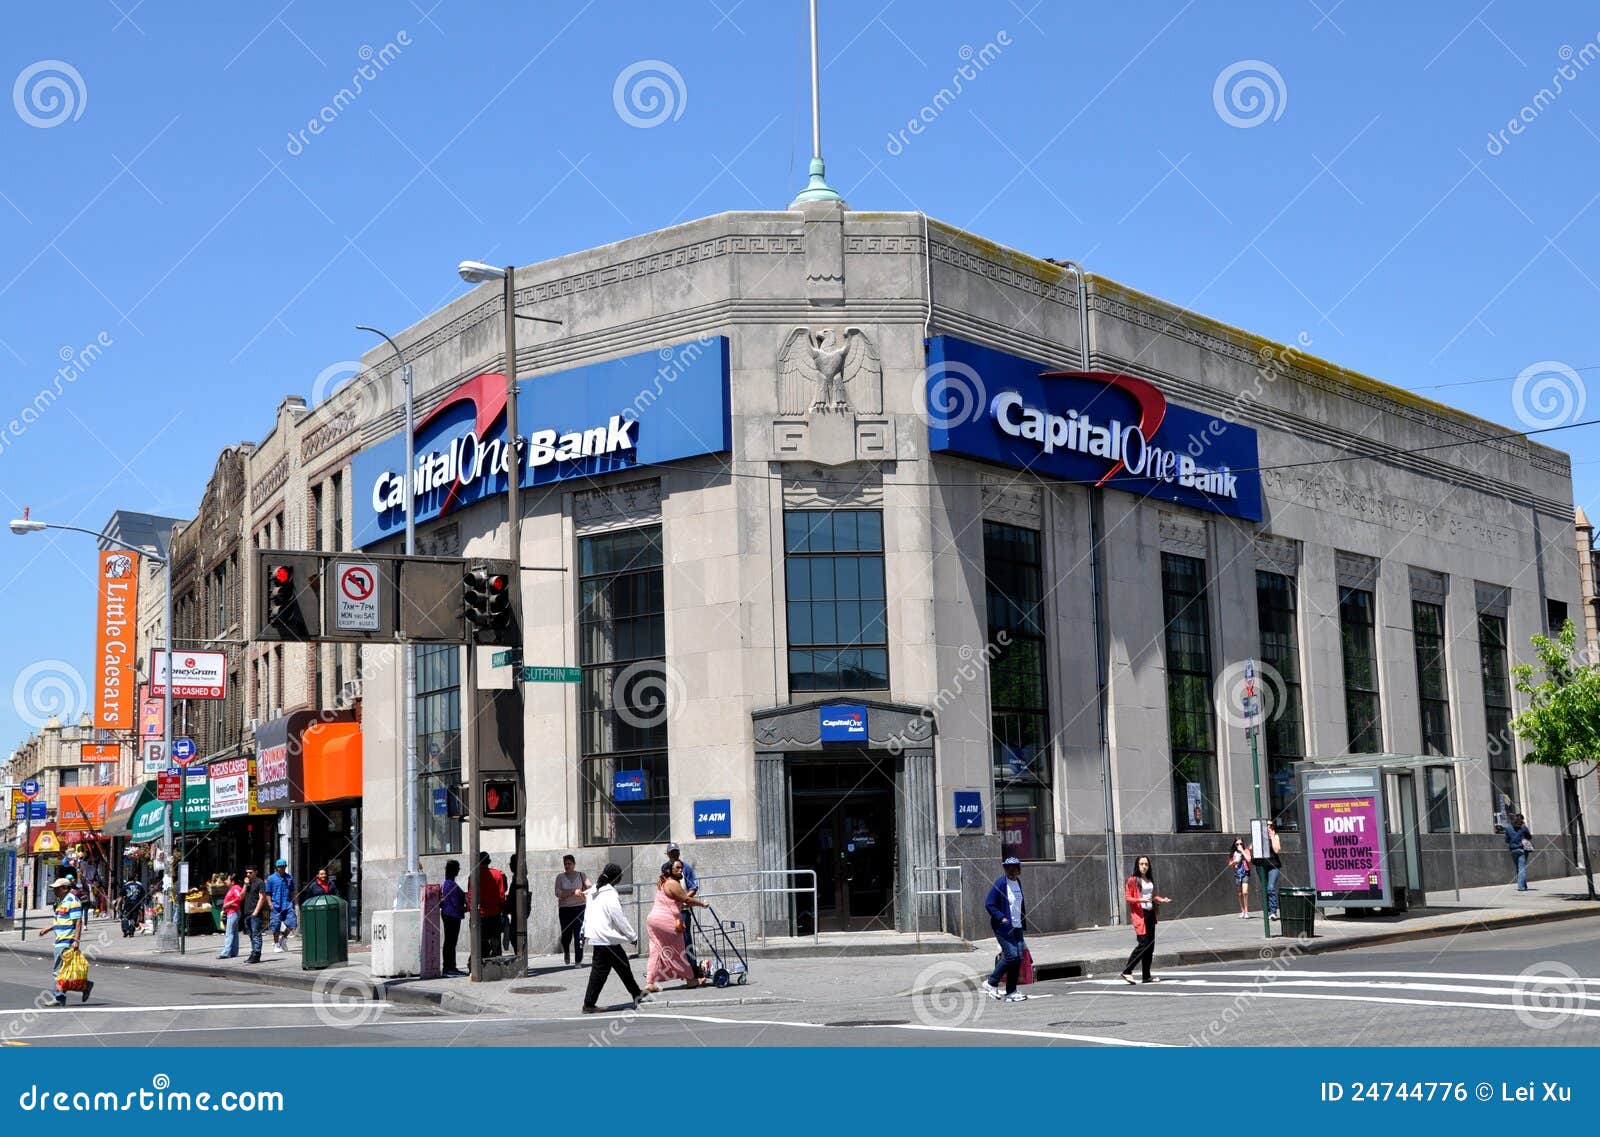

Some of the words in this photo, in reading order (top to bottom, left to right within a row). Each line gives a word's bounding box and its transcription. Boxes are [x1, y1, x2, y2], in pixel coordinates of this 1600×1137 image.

[529, 415, 634, 468] Bank
[1177, 454, 1238, 499] Bank
[105, 582, 128, 637] Little
[104, 641, 127, 721] Caesars
[525, 669, 566, 681] SUTPHIN
[153, 686, 181, 695] CHEKS
[181, 687, 209, 696] CASHED
[210, 762, 229, 777] CHECKS
[229, 758, 247, 774] CASHED
[958, 804, 966, 814] 24
[966, 804, 979, 814] ATM
[698, 814, 709, 823] 24
[709, 813, 726, 822] ATM
[1324, 816, 1365, 834] DON'T
[1333, 835, 1359, 846] MIND
[1322, 847, 1348, 858] YOUR
[1350, 847, 1372, 858] OWN
[1325, 859, 1373, 870] BUSINESS
